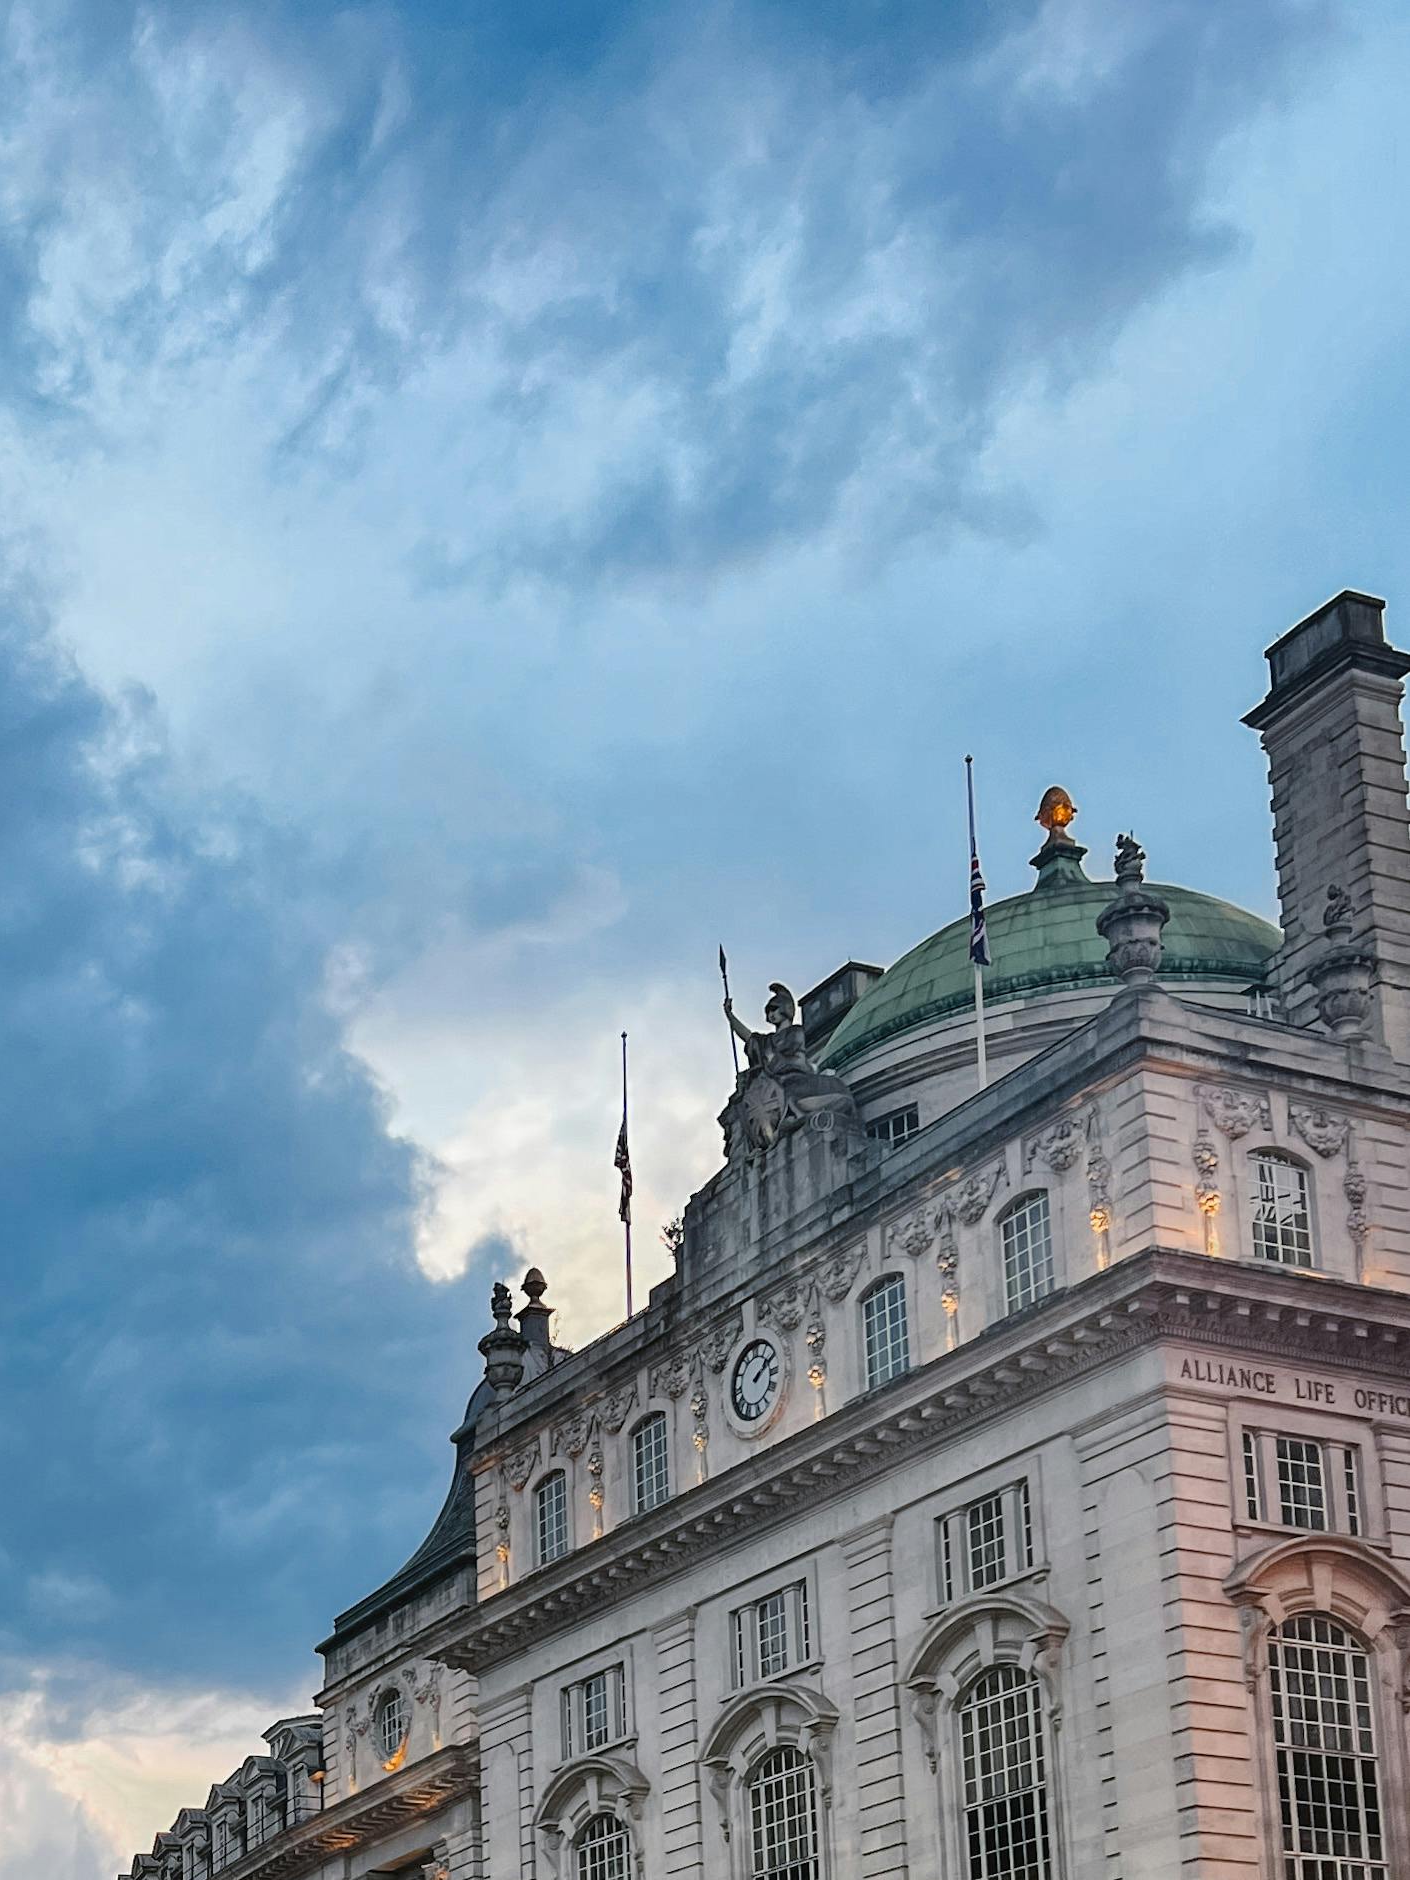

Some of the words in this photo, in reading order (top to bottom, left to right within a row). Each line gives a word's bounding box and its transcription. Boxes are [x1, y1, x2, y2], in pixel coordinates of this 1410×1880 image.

[1180, 1357, 1277, 1394] ALLIANCE
[1294, 1377, 1336, 1404] LIFE
[1354, 1388, 1410, 1418] OFFIC
